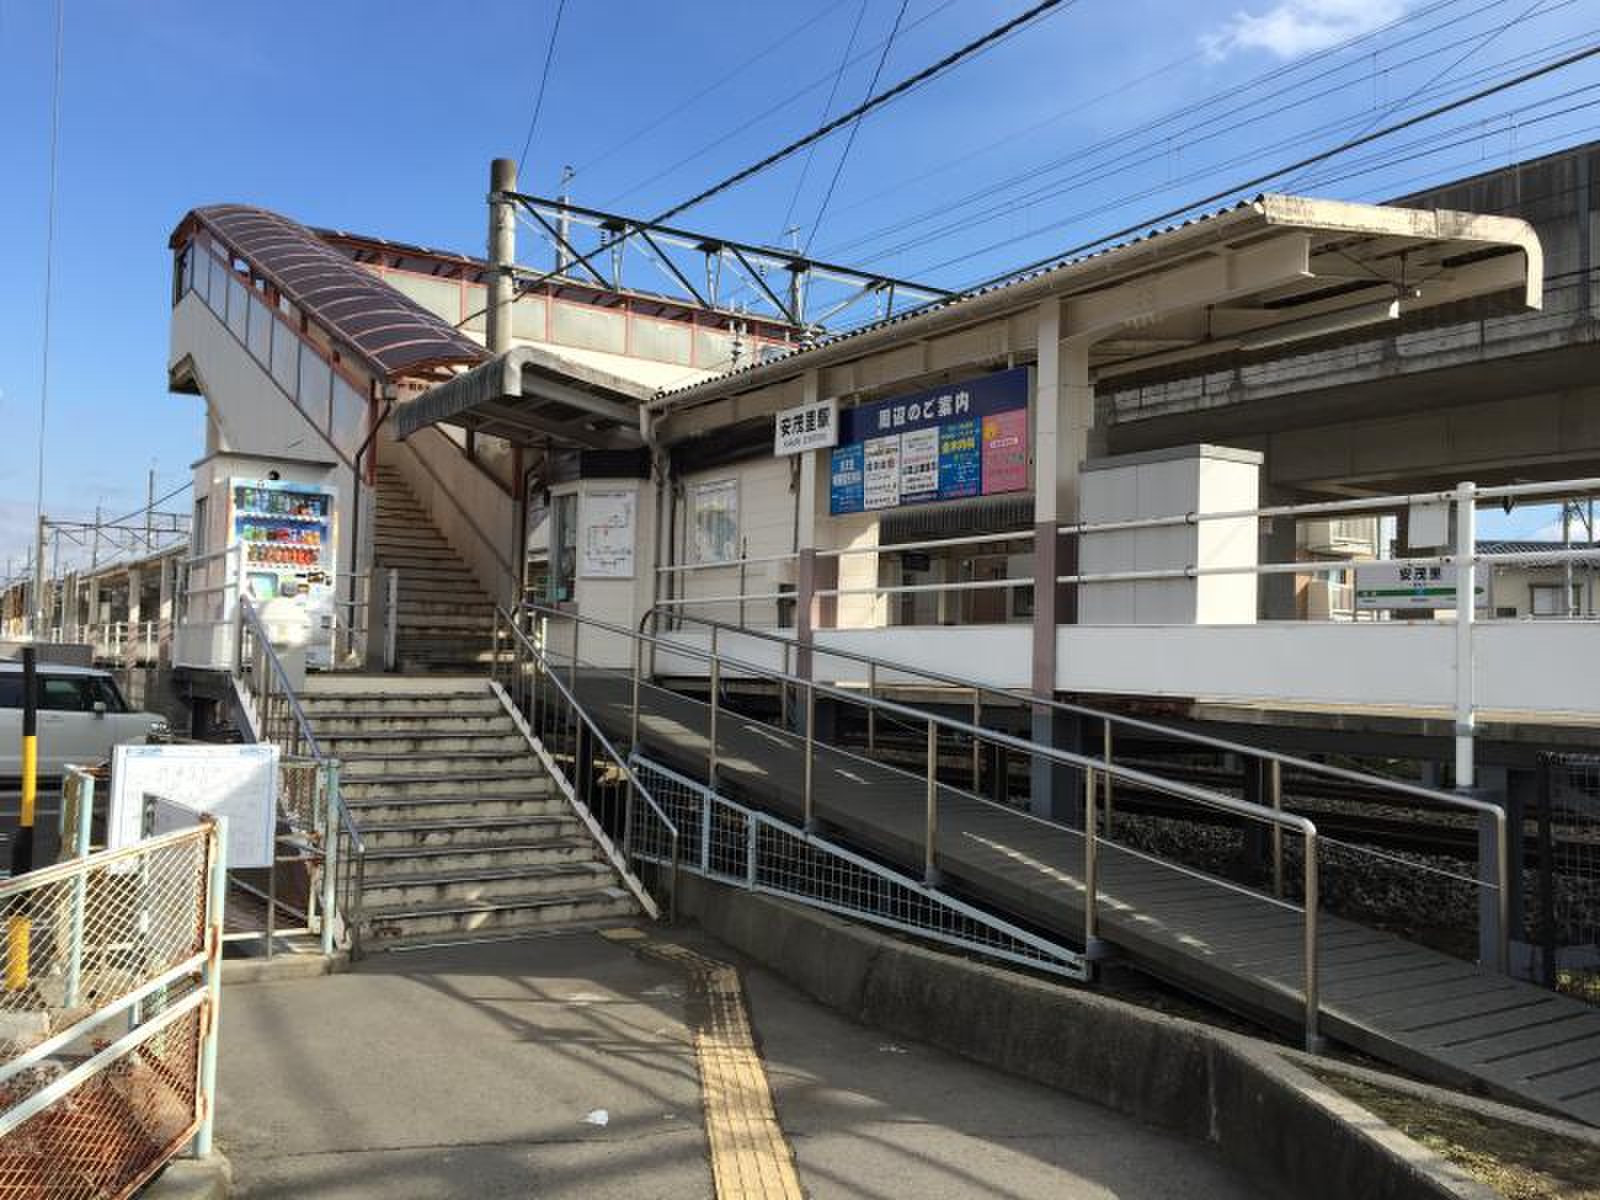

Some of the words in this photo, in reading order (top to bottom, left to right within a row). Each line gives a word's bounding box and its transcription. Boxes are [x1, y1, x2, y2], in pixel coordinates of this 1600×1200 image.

[780, 406, 830, 438] 安茂里駅
[878, 391, 970, 430] 周辺のご案内
[1400, 567, 1441, 581] 安茂里
